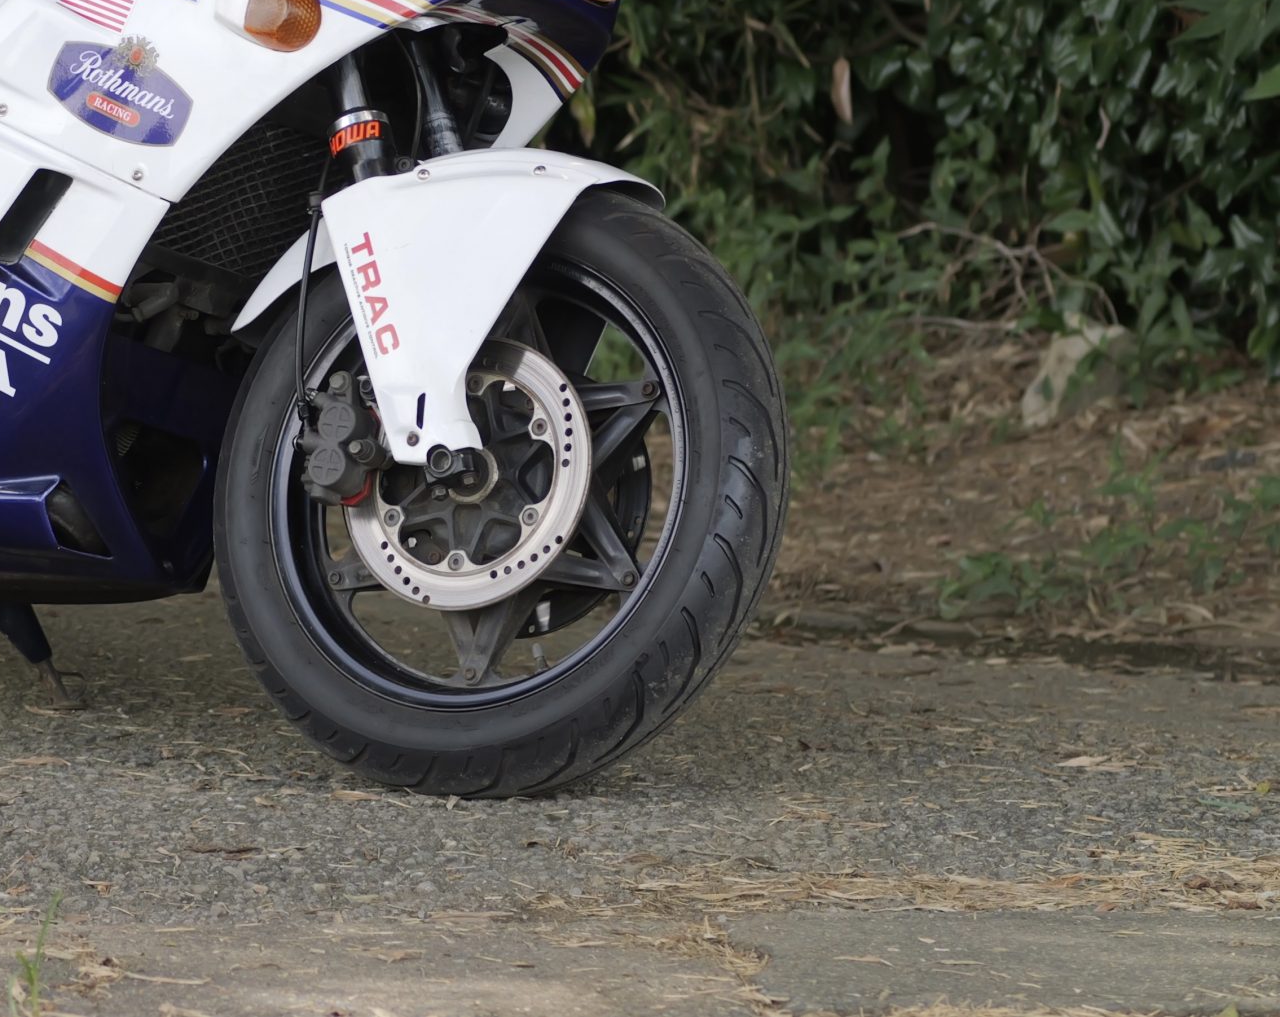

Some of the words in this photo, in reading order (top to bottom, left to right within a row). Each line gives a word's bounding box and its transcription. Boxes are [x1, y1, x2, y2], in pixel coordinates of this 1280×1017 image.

[68, 50, 175, 119] Rothmans
[94, 97, 132, 122] RACING
[351, 231, 400, 355] TRAC
